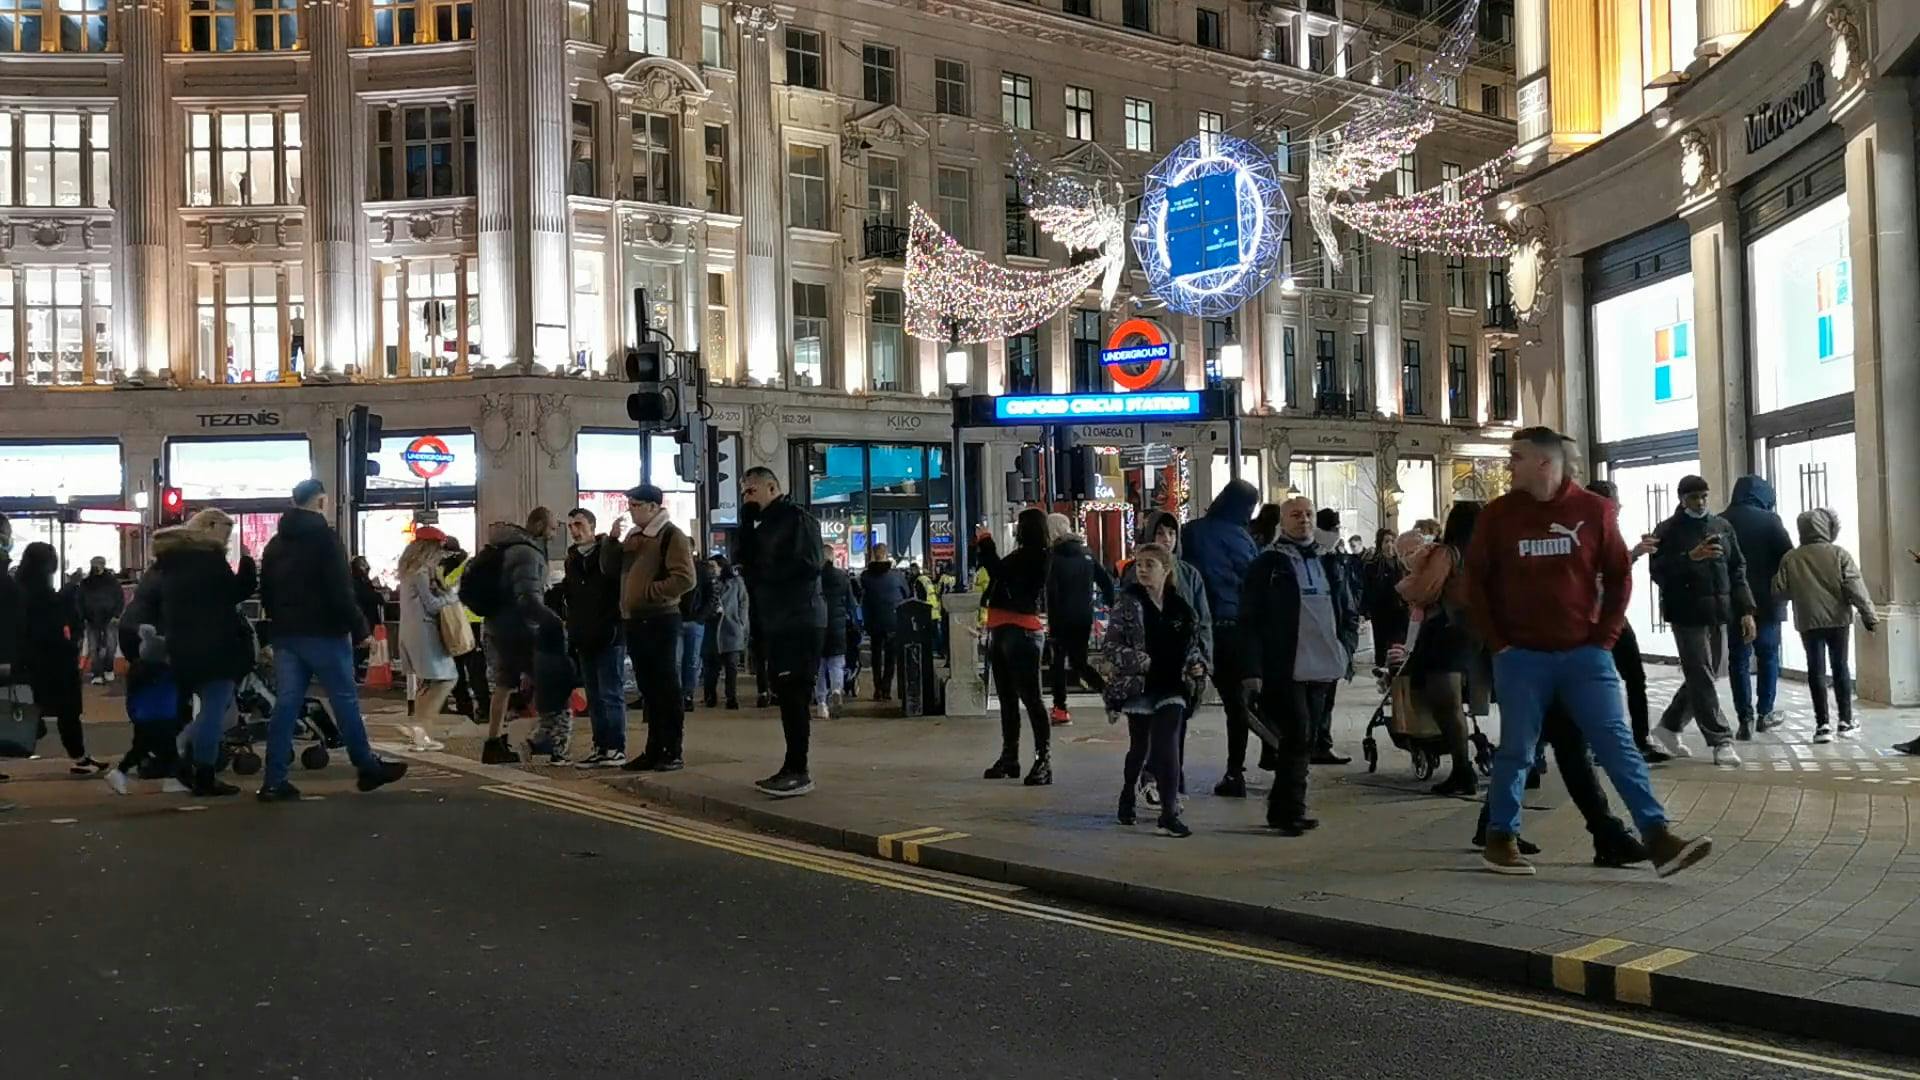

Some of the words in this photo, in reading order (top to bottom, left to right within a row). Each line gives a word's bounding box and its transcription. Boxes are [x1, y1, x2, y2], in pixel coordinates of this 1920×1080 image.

[1743, 60, 1825, 154] Microsoft
[1103, 347, 1167, 362] UNDERGROUND
[1006, 399, 1069, 415] OXFORD
[1070, 398, 1123, 413] CIRCUS
[1125, 396, 1190, 412] STATION
[887, 415, 921, 428] KIKO
[1093, 428, 1123, 438] OMEGA
[1095, 486, 1115, 498] EGA
[820, 521, 845, 534] IKO
[1519, 536, 1571, 557] PUMA
